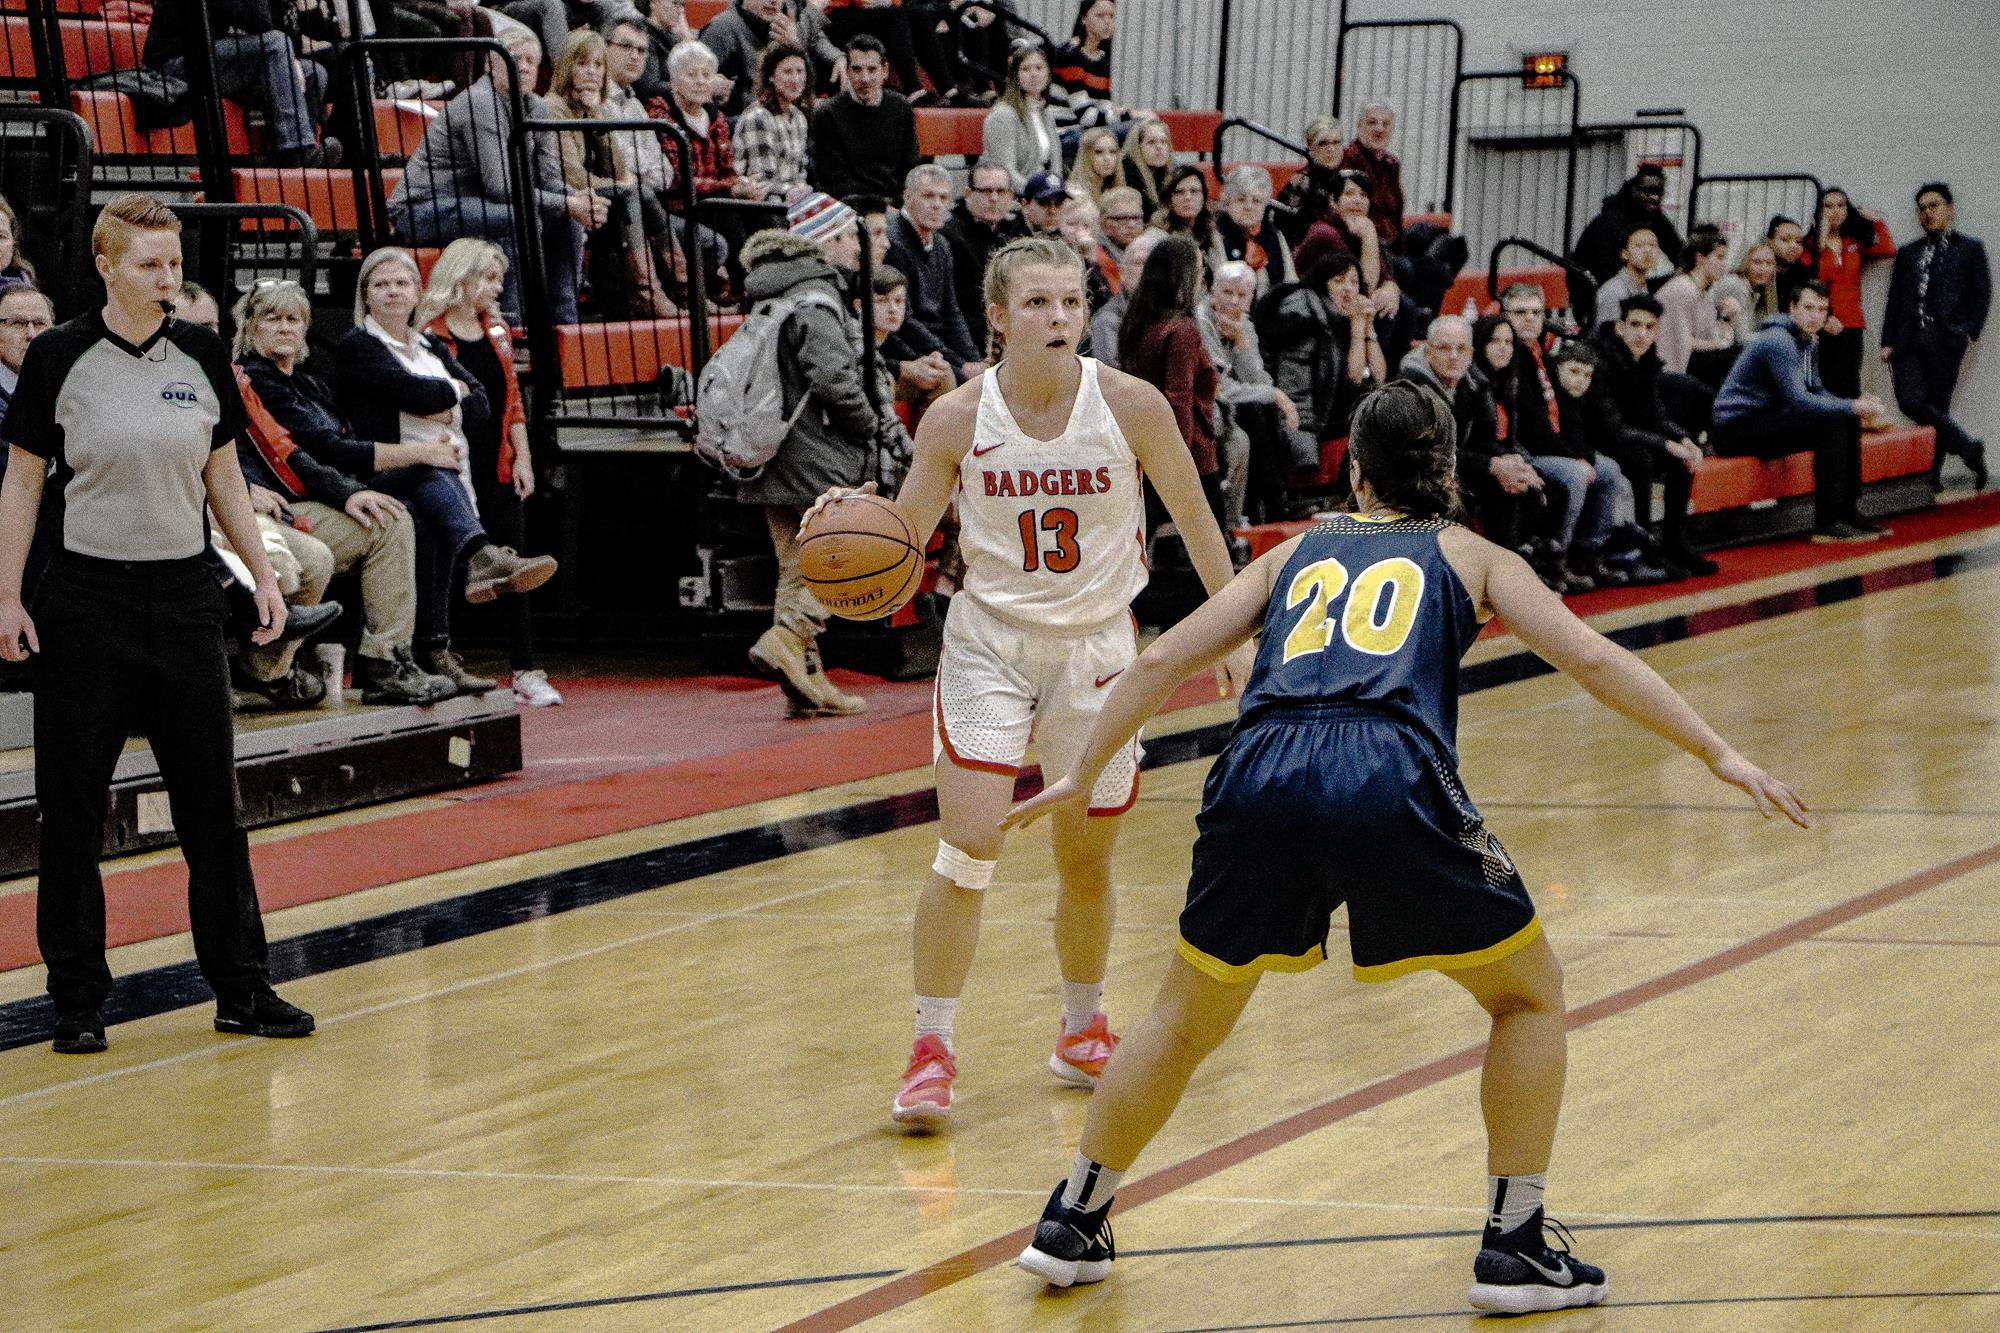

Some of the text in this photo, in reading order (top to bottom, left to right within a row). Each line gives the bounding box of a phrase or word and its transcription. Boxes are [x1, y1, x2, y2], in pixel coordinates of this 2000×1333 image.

[162, 391, 197, 401] OUA
[982, 466, 1112, 496] BADGERS
[1018, 507, 1081, 573] 13
[1283, 557, 1425, 665] 20
